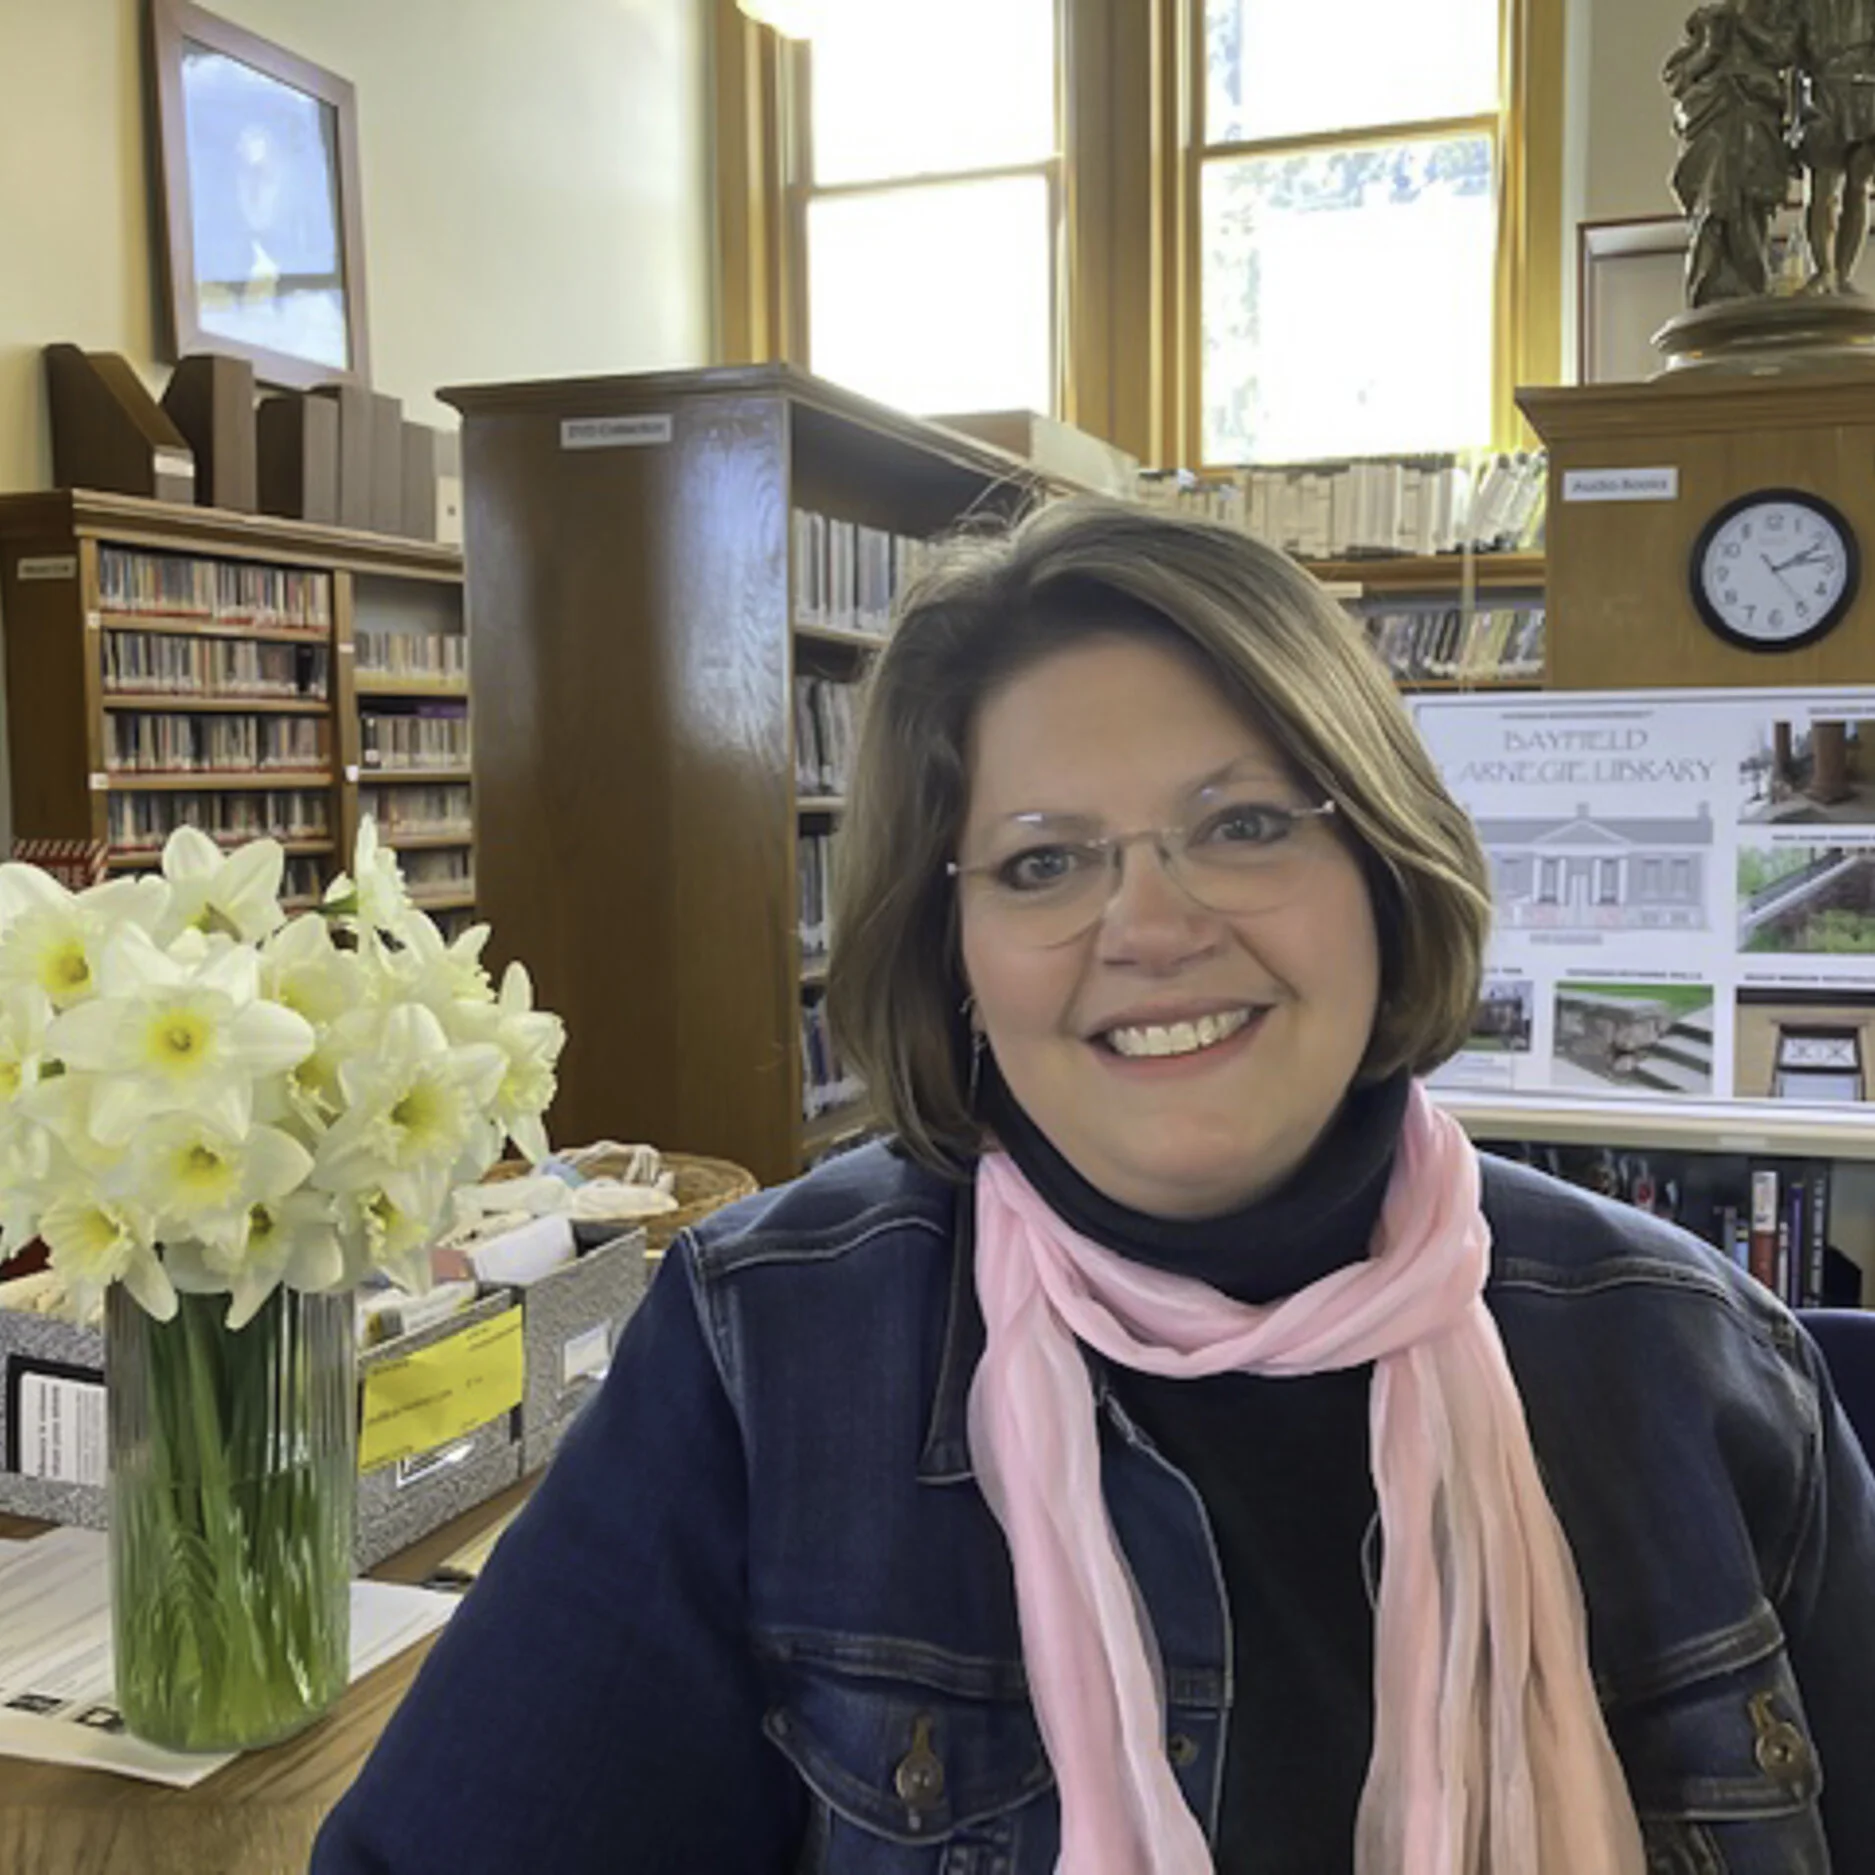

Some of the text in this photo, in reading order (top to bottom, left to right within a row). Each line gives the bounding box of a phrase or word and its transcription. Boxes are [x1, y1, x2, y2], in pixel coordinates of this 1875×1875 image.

[1503, 727, 1650, 752] BAYFIELD
[1440, 755, 1718, 783] ARNEGIE LIBRARY
